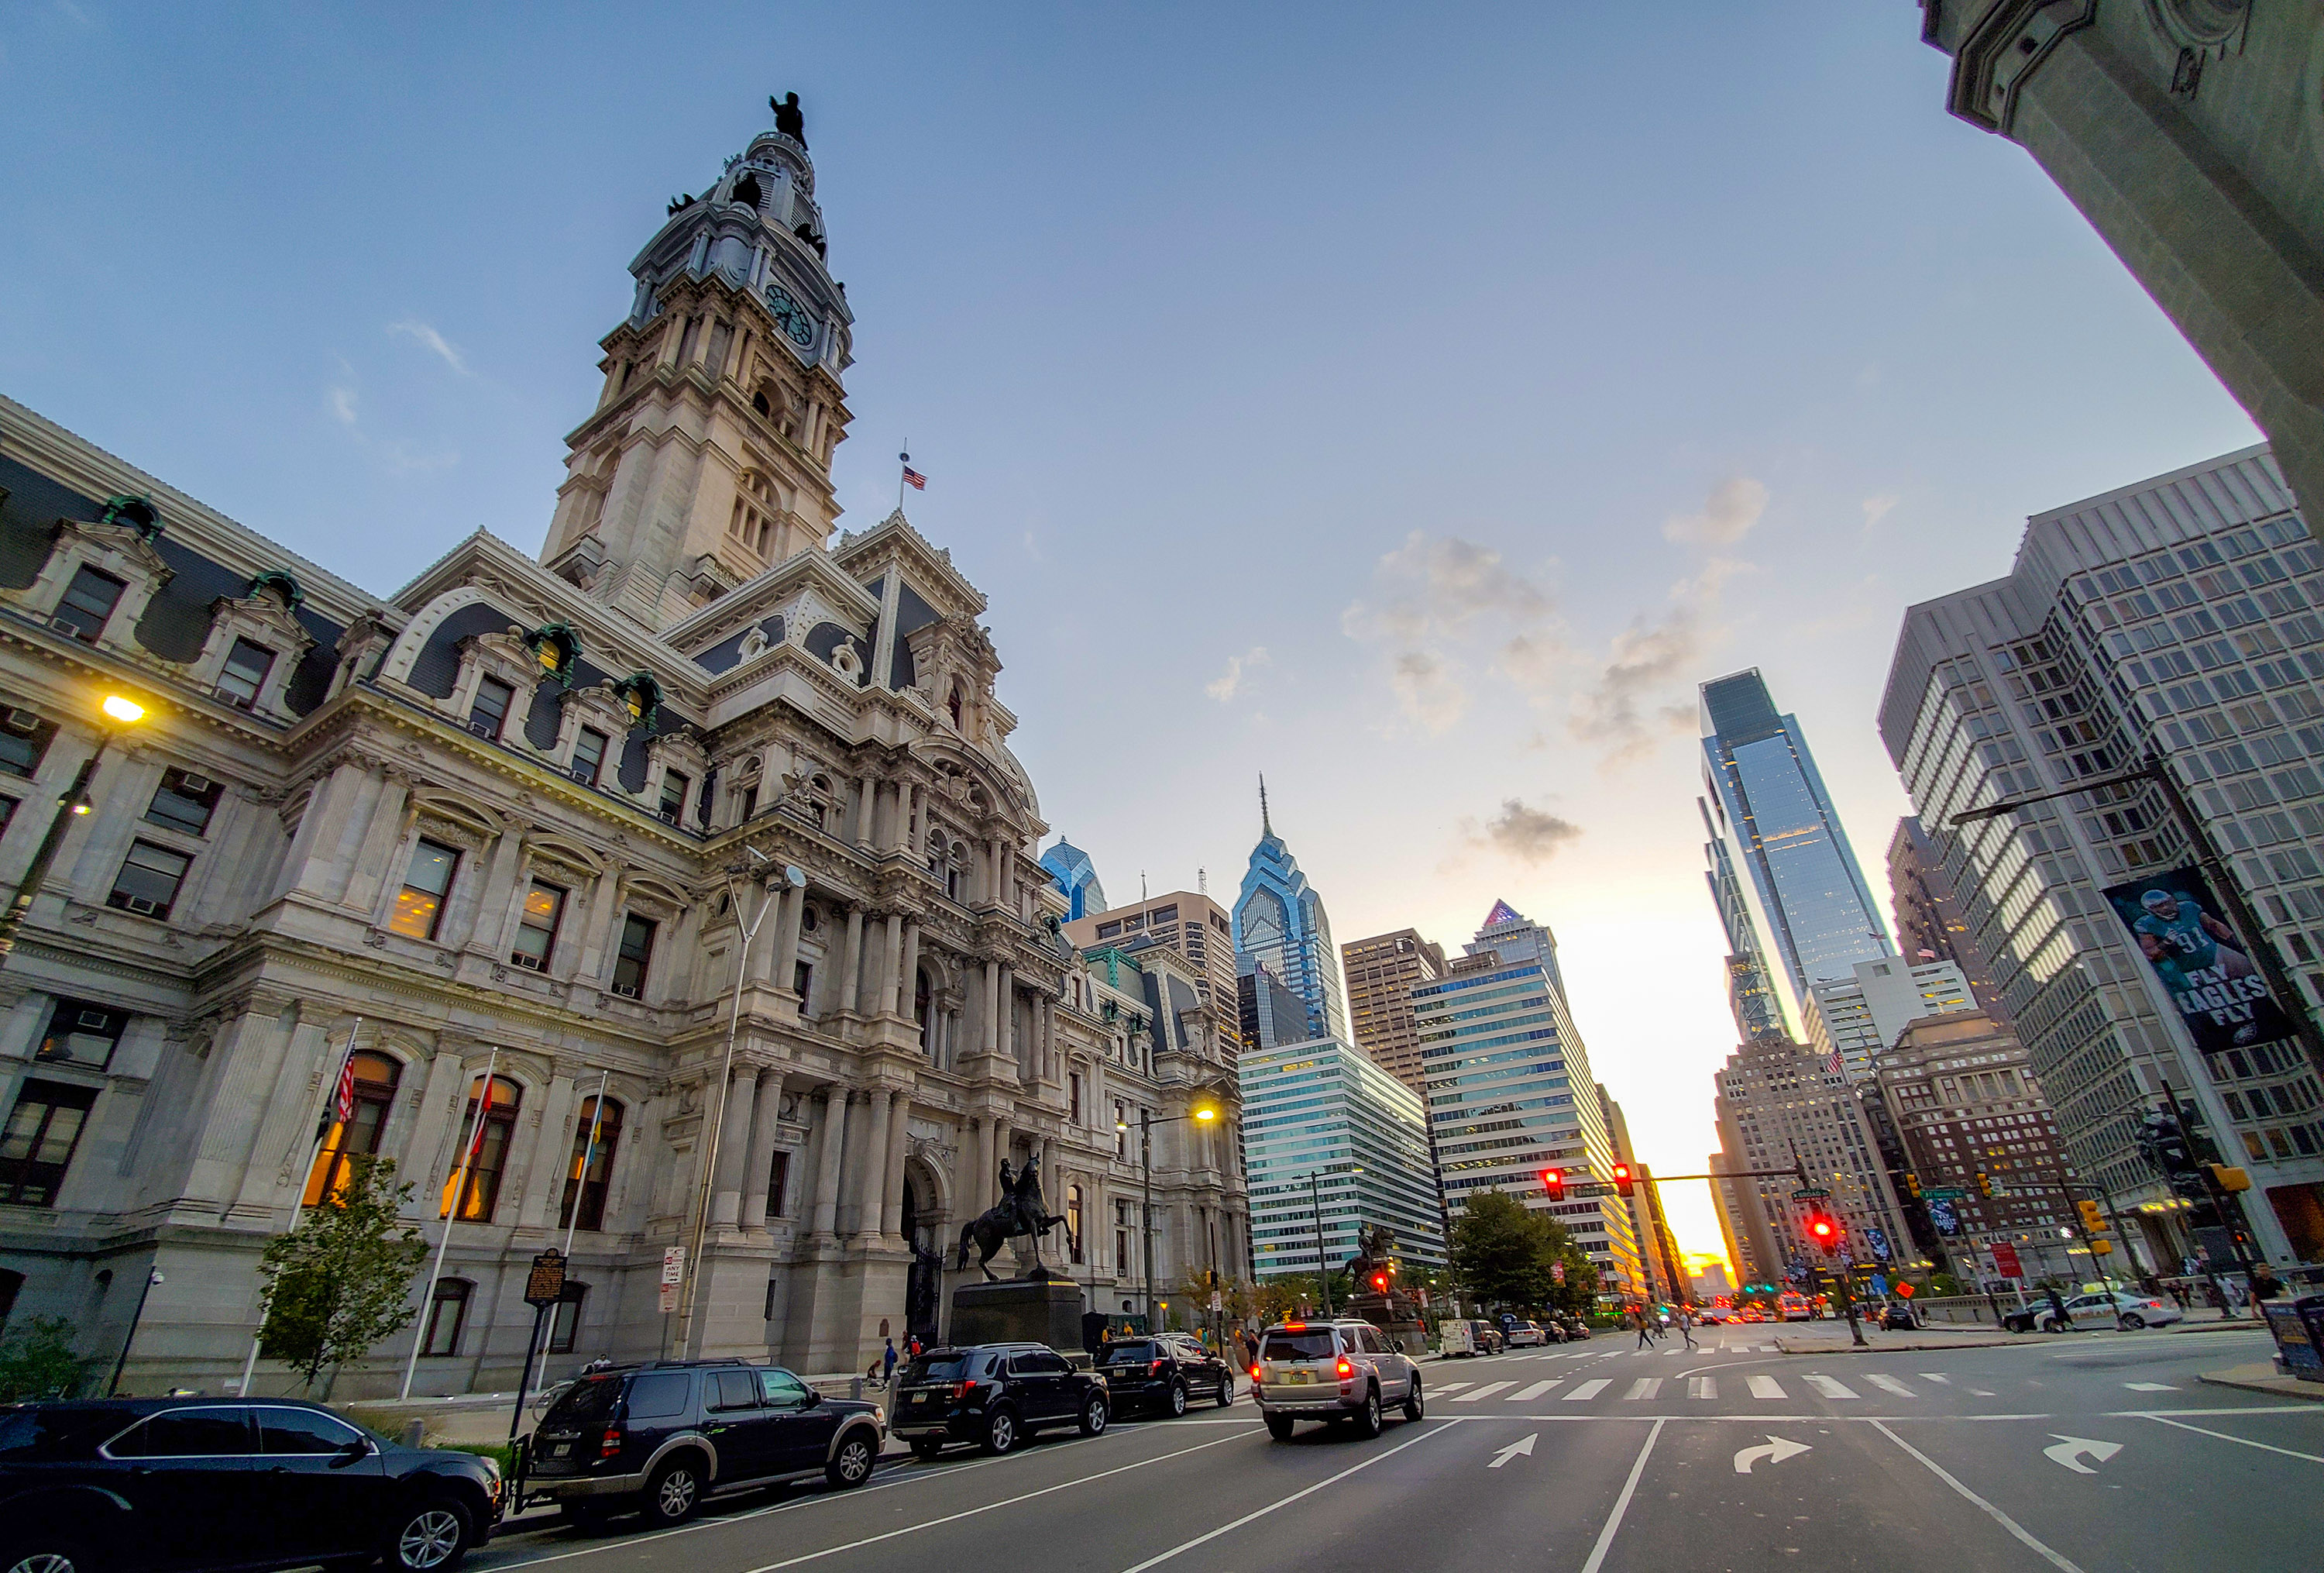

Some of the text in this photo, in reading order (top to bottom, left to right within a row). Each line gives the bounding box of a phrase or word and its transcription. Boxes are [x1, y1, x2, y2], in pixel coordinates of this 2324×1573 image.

[2176, 928, 2209, 954] 91
[2185, 964, 2229, 987] FLY
[2175, 975, 2266, 1014] EAGLES
[2209, 1003, 2254, 1026] FLY
